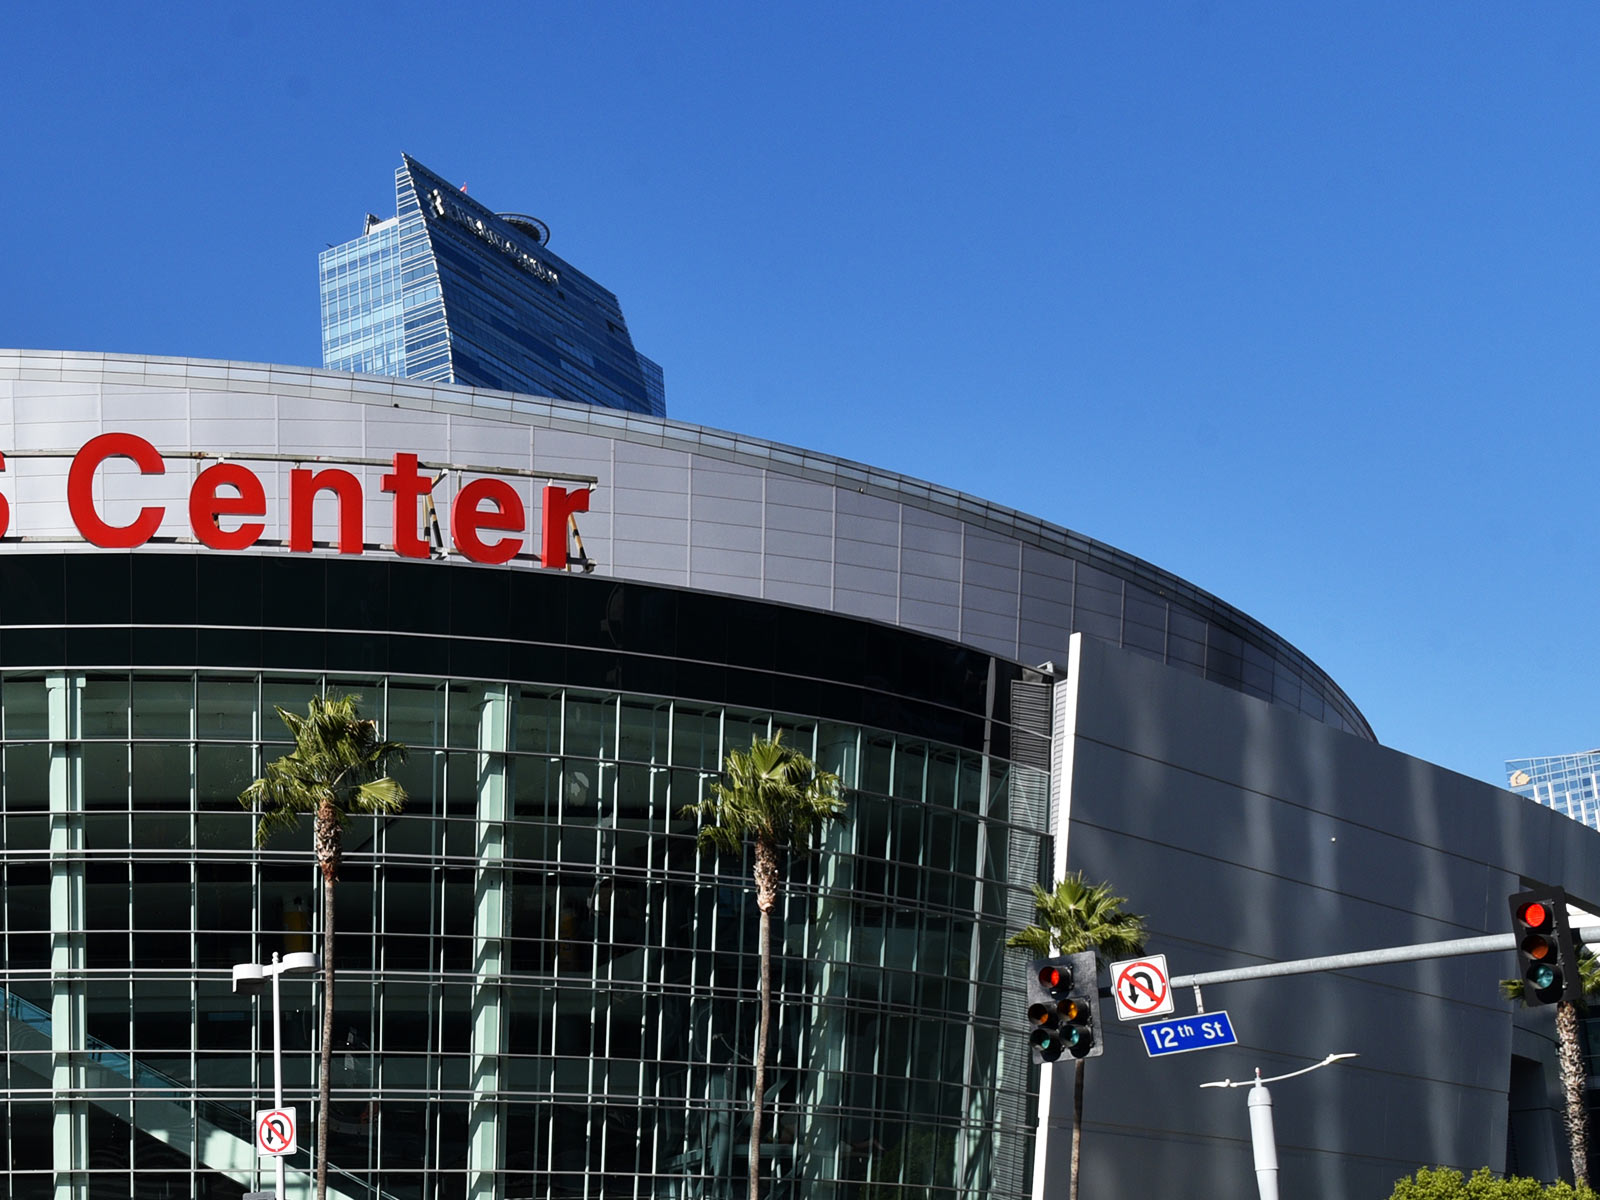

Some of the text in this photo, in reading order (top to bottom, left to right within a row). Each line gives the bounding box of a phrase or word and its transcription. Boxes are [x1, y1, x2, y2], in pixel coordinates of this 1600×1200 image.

[67, 432, 590, 569] Center
[1151, 1021, 1225, 1049] 12th St
